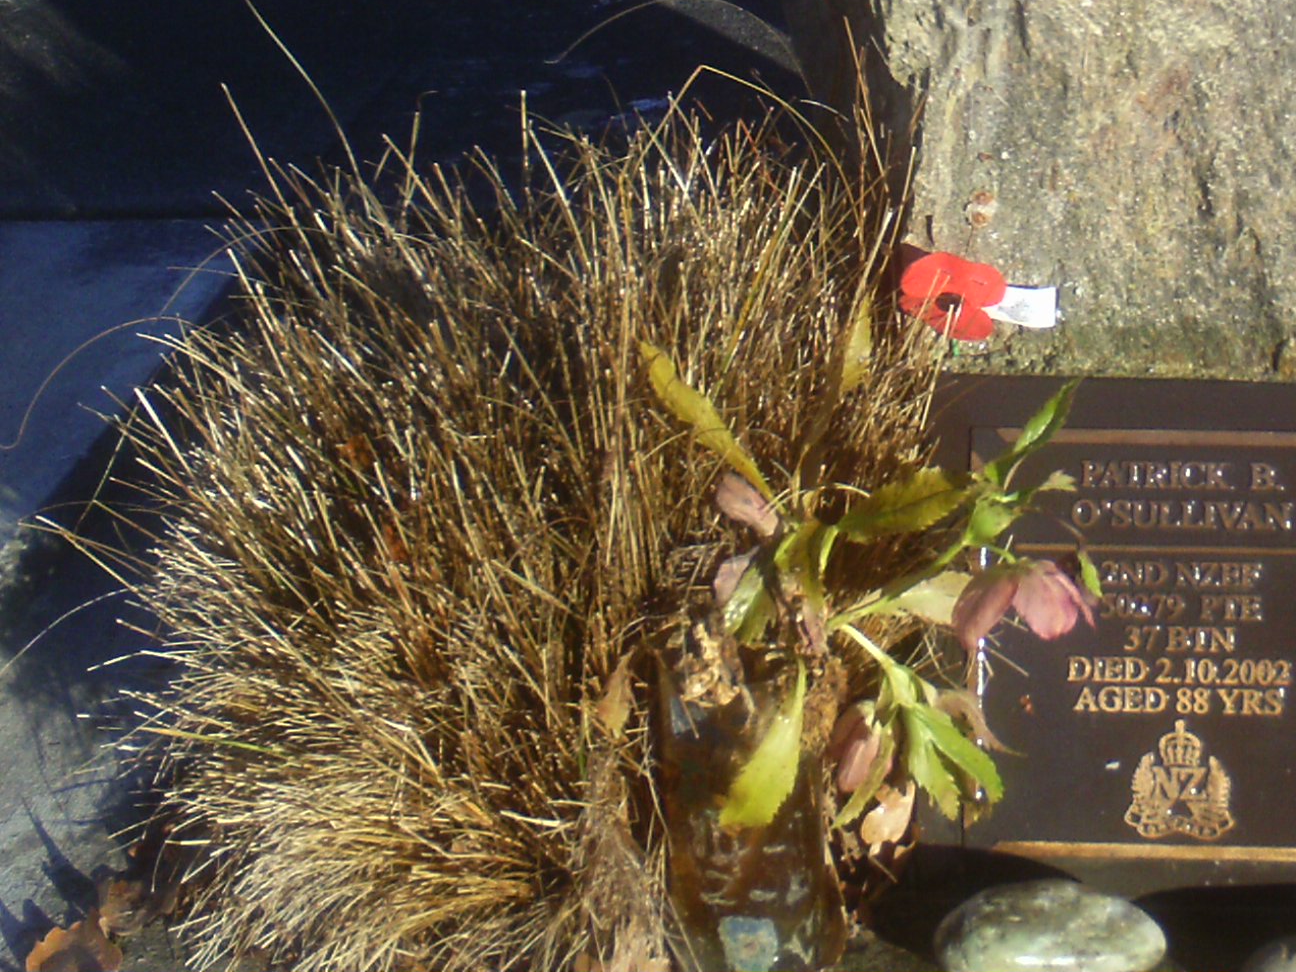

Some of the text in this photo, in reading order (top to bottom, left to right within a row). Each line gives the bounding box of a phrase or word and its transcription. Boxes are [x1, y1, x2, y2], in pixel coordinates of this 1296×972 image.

[1081, 460, 1232, 490] PATRICK
[1250, 462, 1286, 491] B.
[1072, 499, 1294, 531] O'SULLIVAN
[1100, 560, 1264, 589] 2ND NZEF
[1099, 593, 1263, 622] 50279 PTE
[1123, 625, 1237, 653] 37 BTN
[1067, 657, 1293, 686] DIED 2.10.2002
[1073, 686, 1285, 716] AGED 88 YRS
[1151, 766, 1208, 800] NZ
